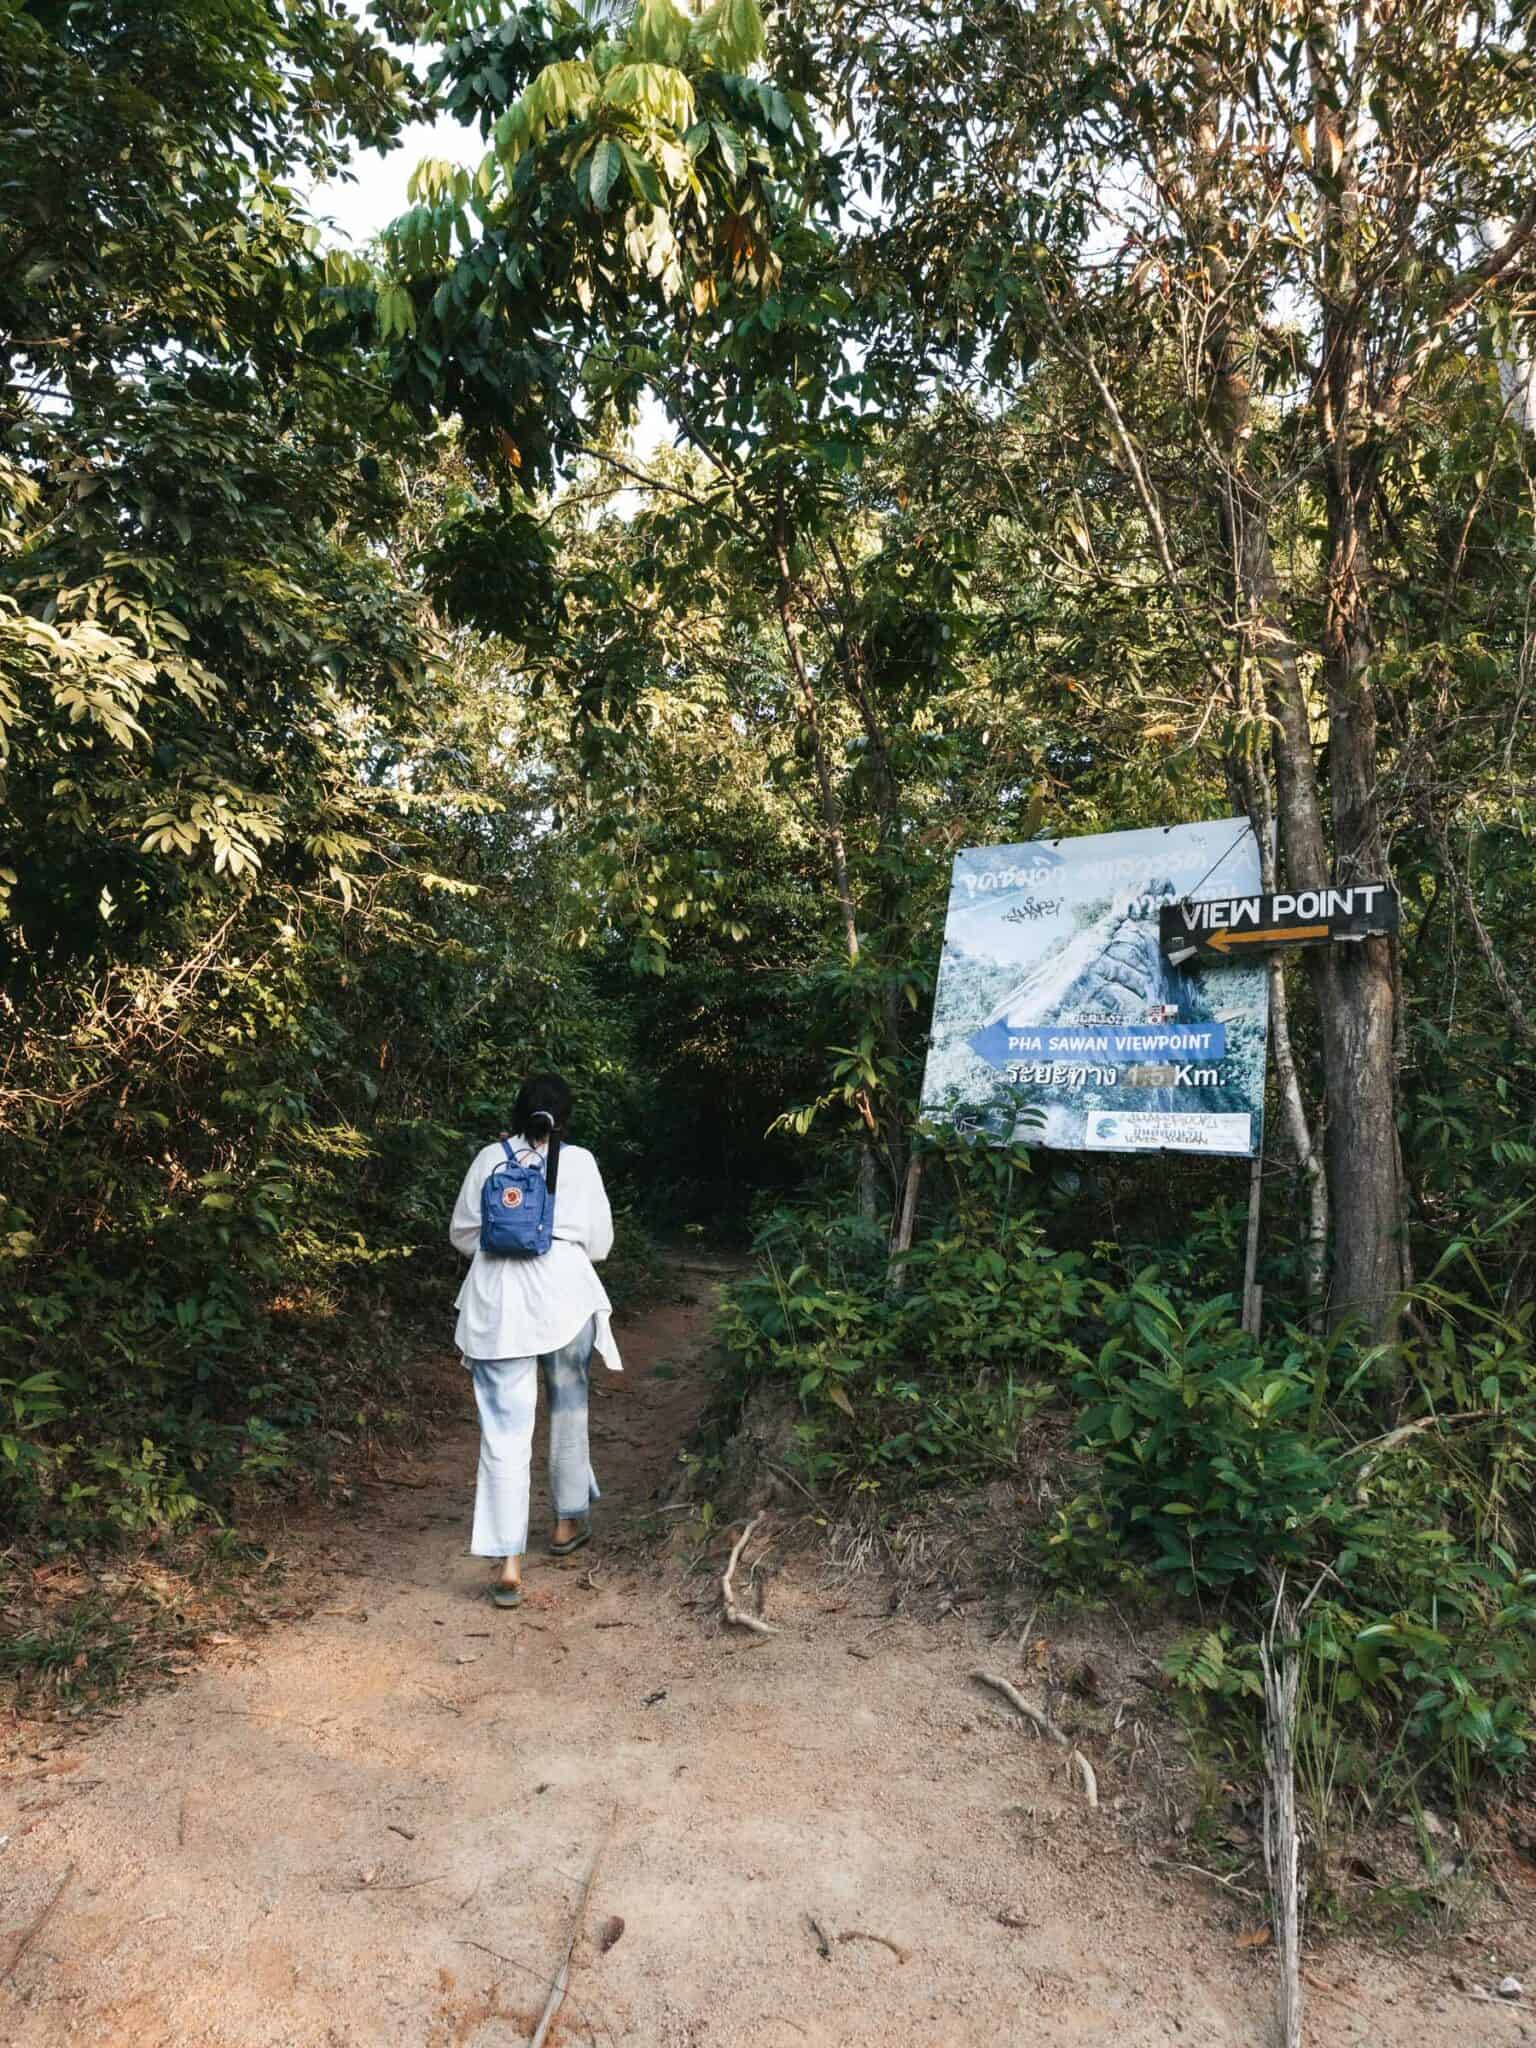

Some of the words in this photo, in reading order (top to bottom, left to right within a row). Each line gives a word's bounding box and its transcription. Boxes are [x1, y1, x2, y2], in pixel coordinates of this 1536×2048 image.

[1182, 896, 1261, 931] VIEW
[1272, 885, 1385, 923] POINT
[1008, 1036, 1042, 1051] PHA
[1049, 1035, 1108, 1051] SAWAN
[1115, 1033, 1212, 1051] VIEWPOINT
[1007, 1063, 1117, 1087] ระยะทาง
[1173, 1065, 1227, 1087] Km.
